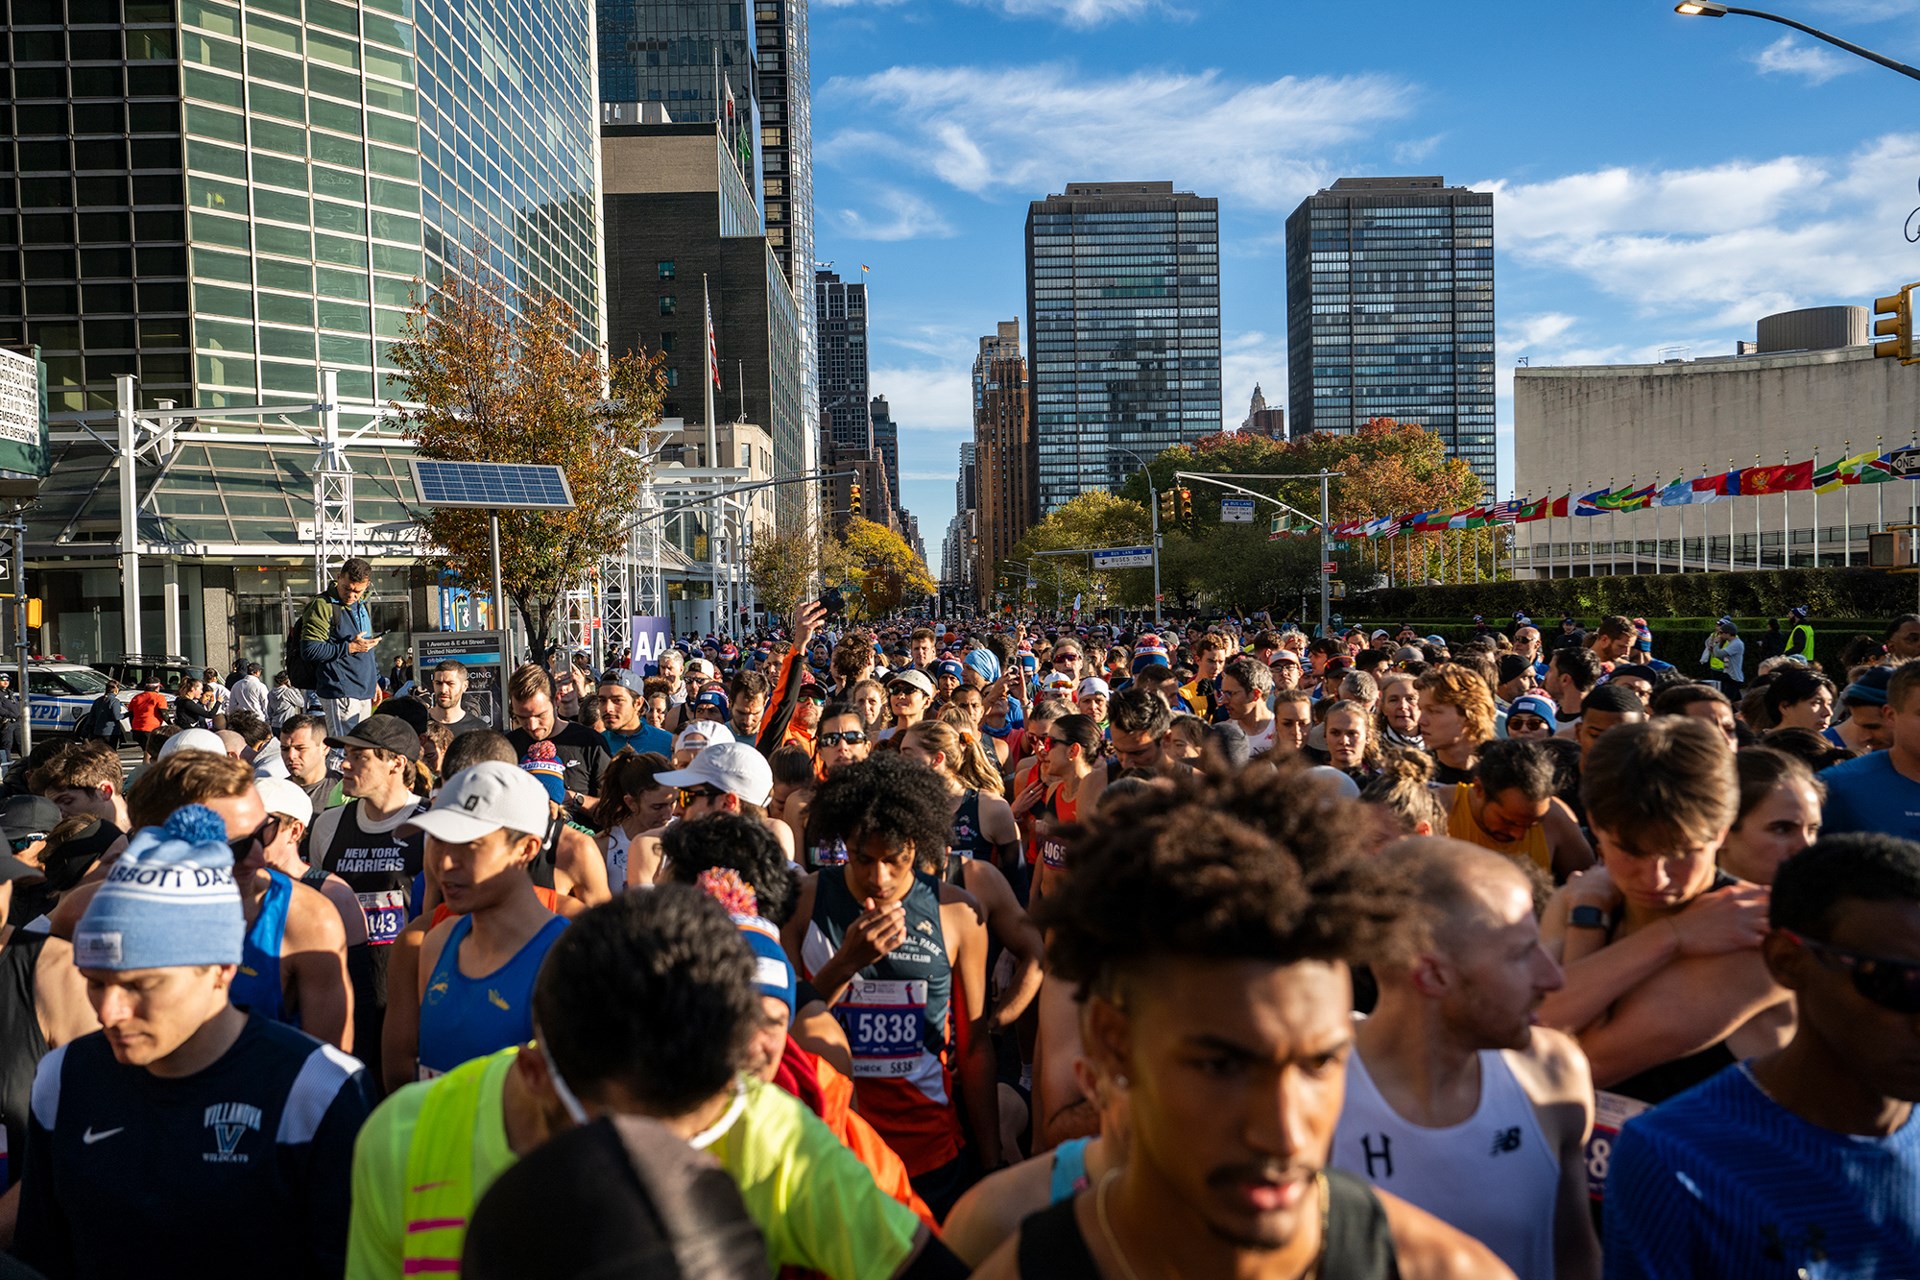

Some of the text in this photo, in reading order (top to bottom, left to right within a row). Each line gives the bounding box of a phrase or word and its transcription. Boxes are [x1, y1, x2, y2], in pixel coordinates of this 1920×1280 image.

[1896, 457, 1915, 468] ONE
[635, 631, 668, 661] AA
[29, 704, 60, 719] YPD
[344, 847, 401, 858] NEW YORK
[336, 858, 405, 872] HARRIERS
[912, 953, 931, 964] CLUB
[858, 1013, 917, 1043] 5838
[854, 1064, 882, 1073] CHECK
[1361, 1131, 1393, 1178] H
